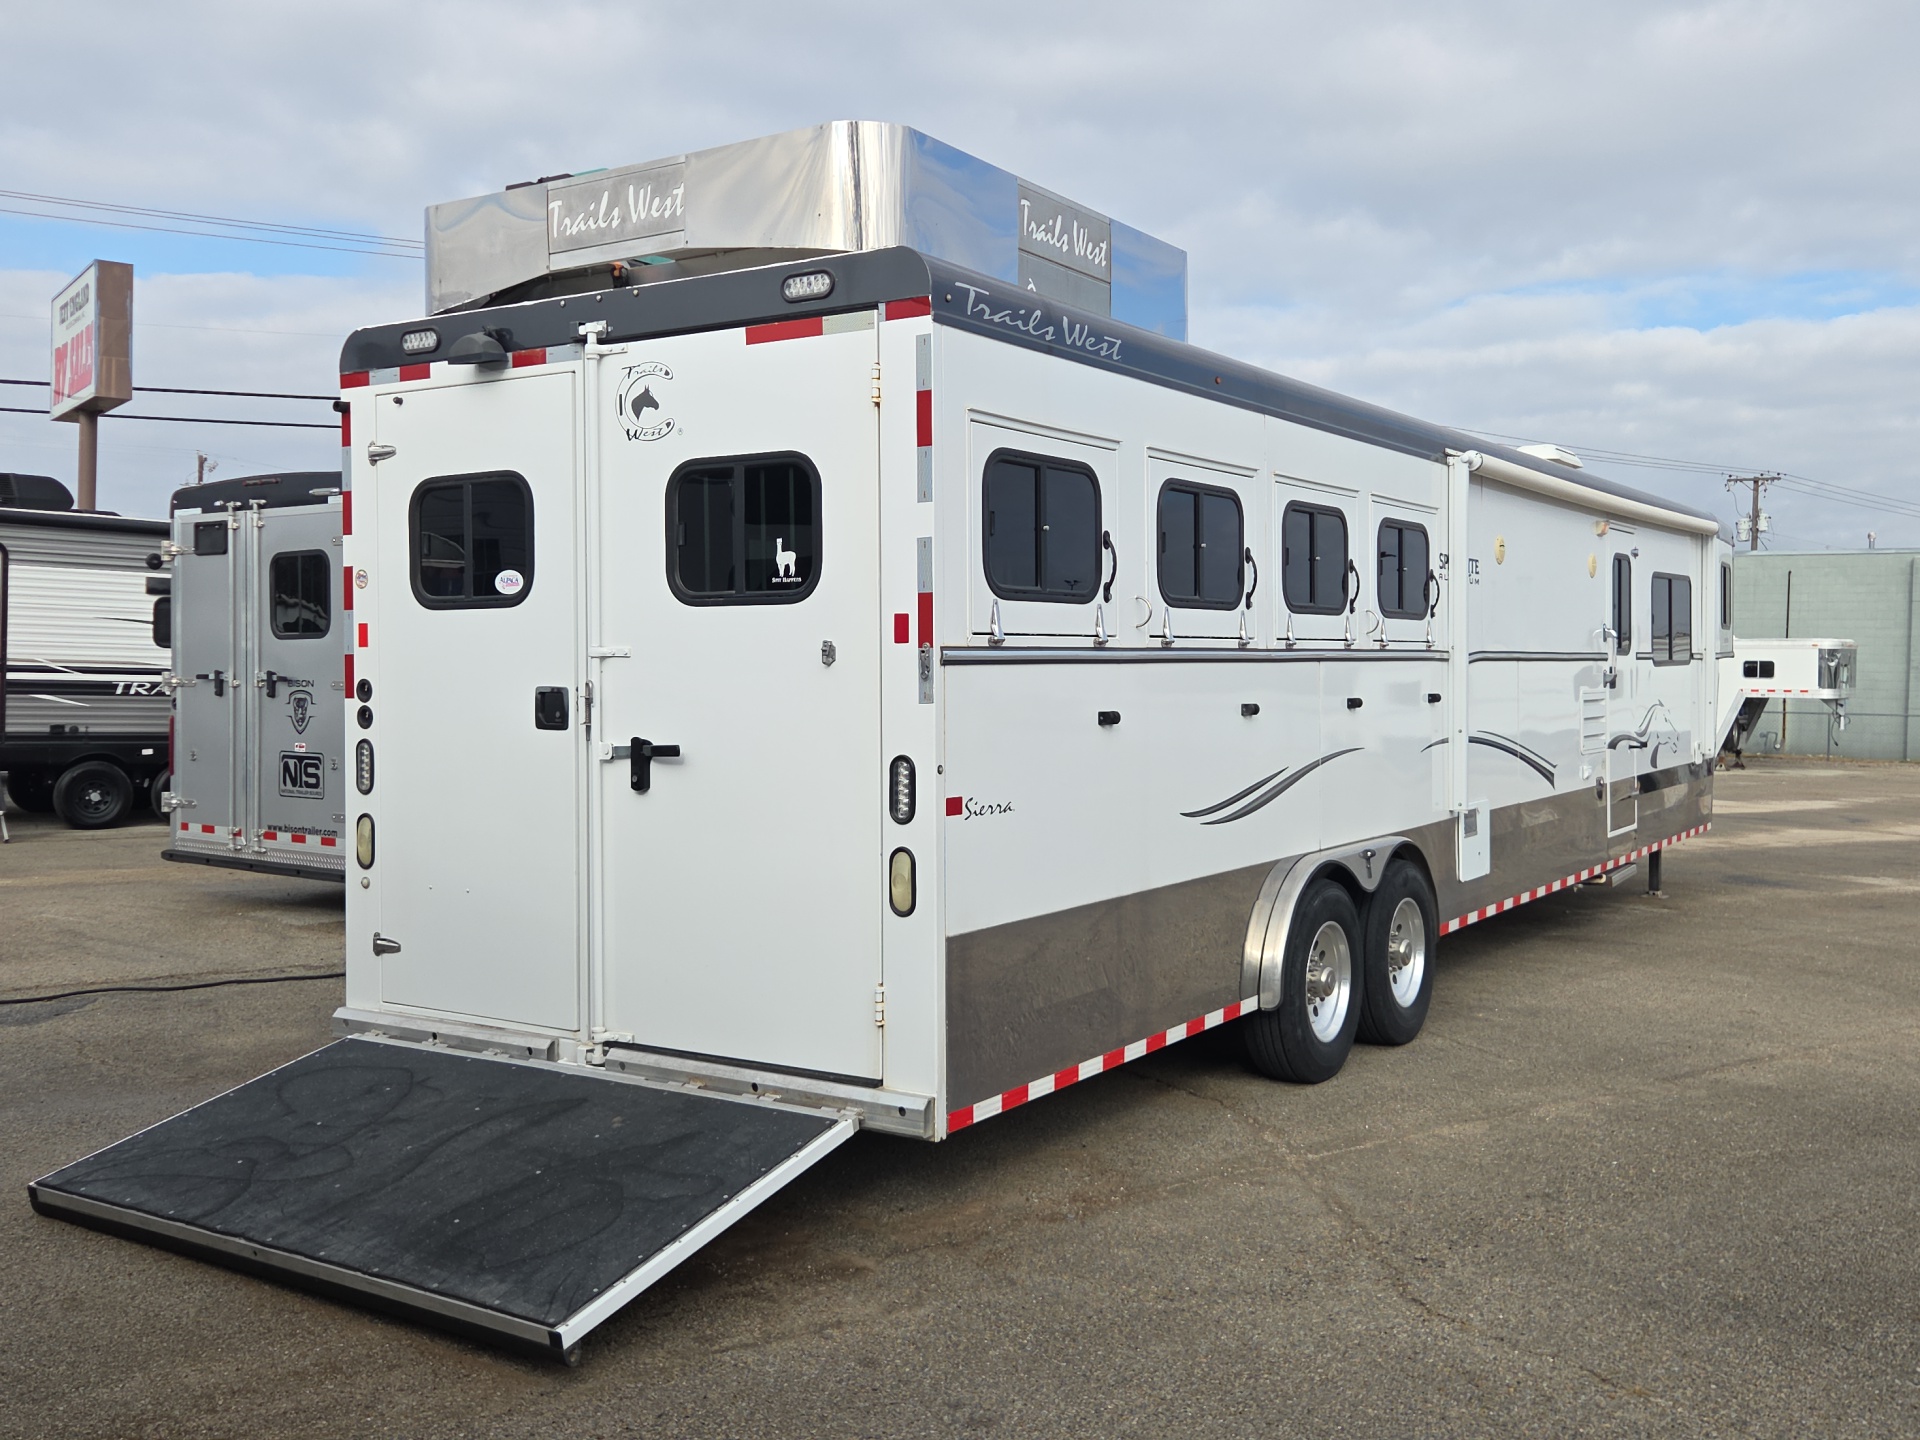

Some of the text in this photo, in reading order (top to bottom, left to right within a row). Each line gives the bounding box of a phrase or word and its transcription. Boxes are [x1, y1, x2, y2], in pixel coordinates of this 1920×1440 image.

[548, 182, 685, 238] Trails West
[1020, 198, 1107, 267] Trails West
[954, 281, 1122, 361] Trails West
[621, 364, 664, 380] Trails
[626, 426, 664, 441] West
[287, 679, 315, 687] BISON
[281, 754, 322, 789] NTS
[964, 797, 1013, 821] Sierra
[267, 824, 338, 837] www.bisontrailer.com
